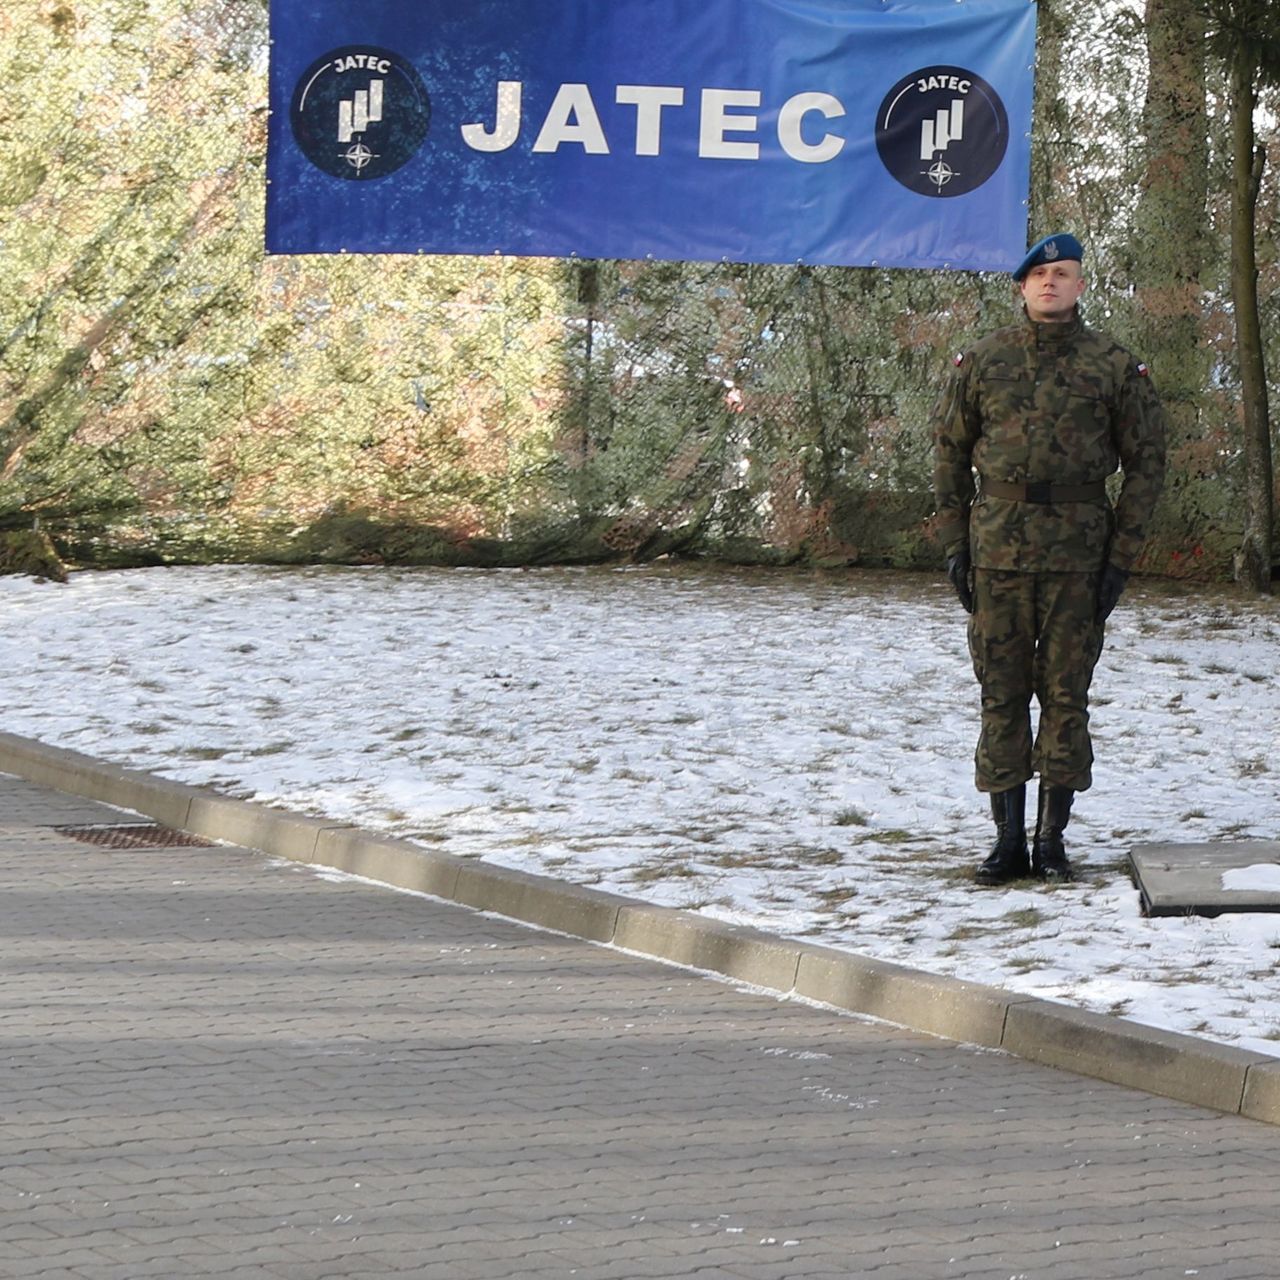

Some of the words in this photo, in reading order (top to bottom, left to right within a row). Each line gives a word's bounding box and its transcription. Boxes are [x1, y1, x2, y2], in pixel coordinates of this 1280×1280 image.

[334, 54, 391, 74] JATEC
[917, 74, 971, 94] JATEC
[460, 80, 846, 163] JATEC
